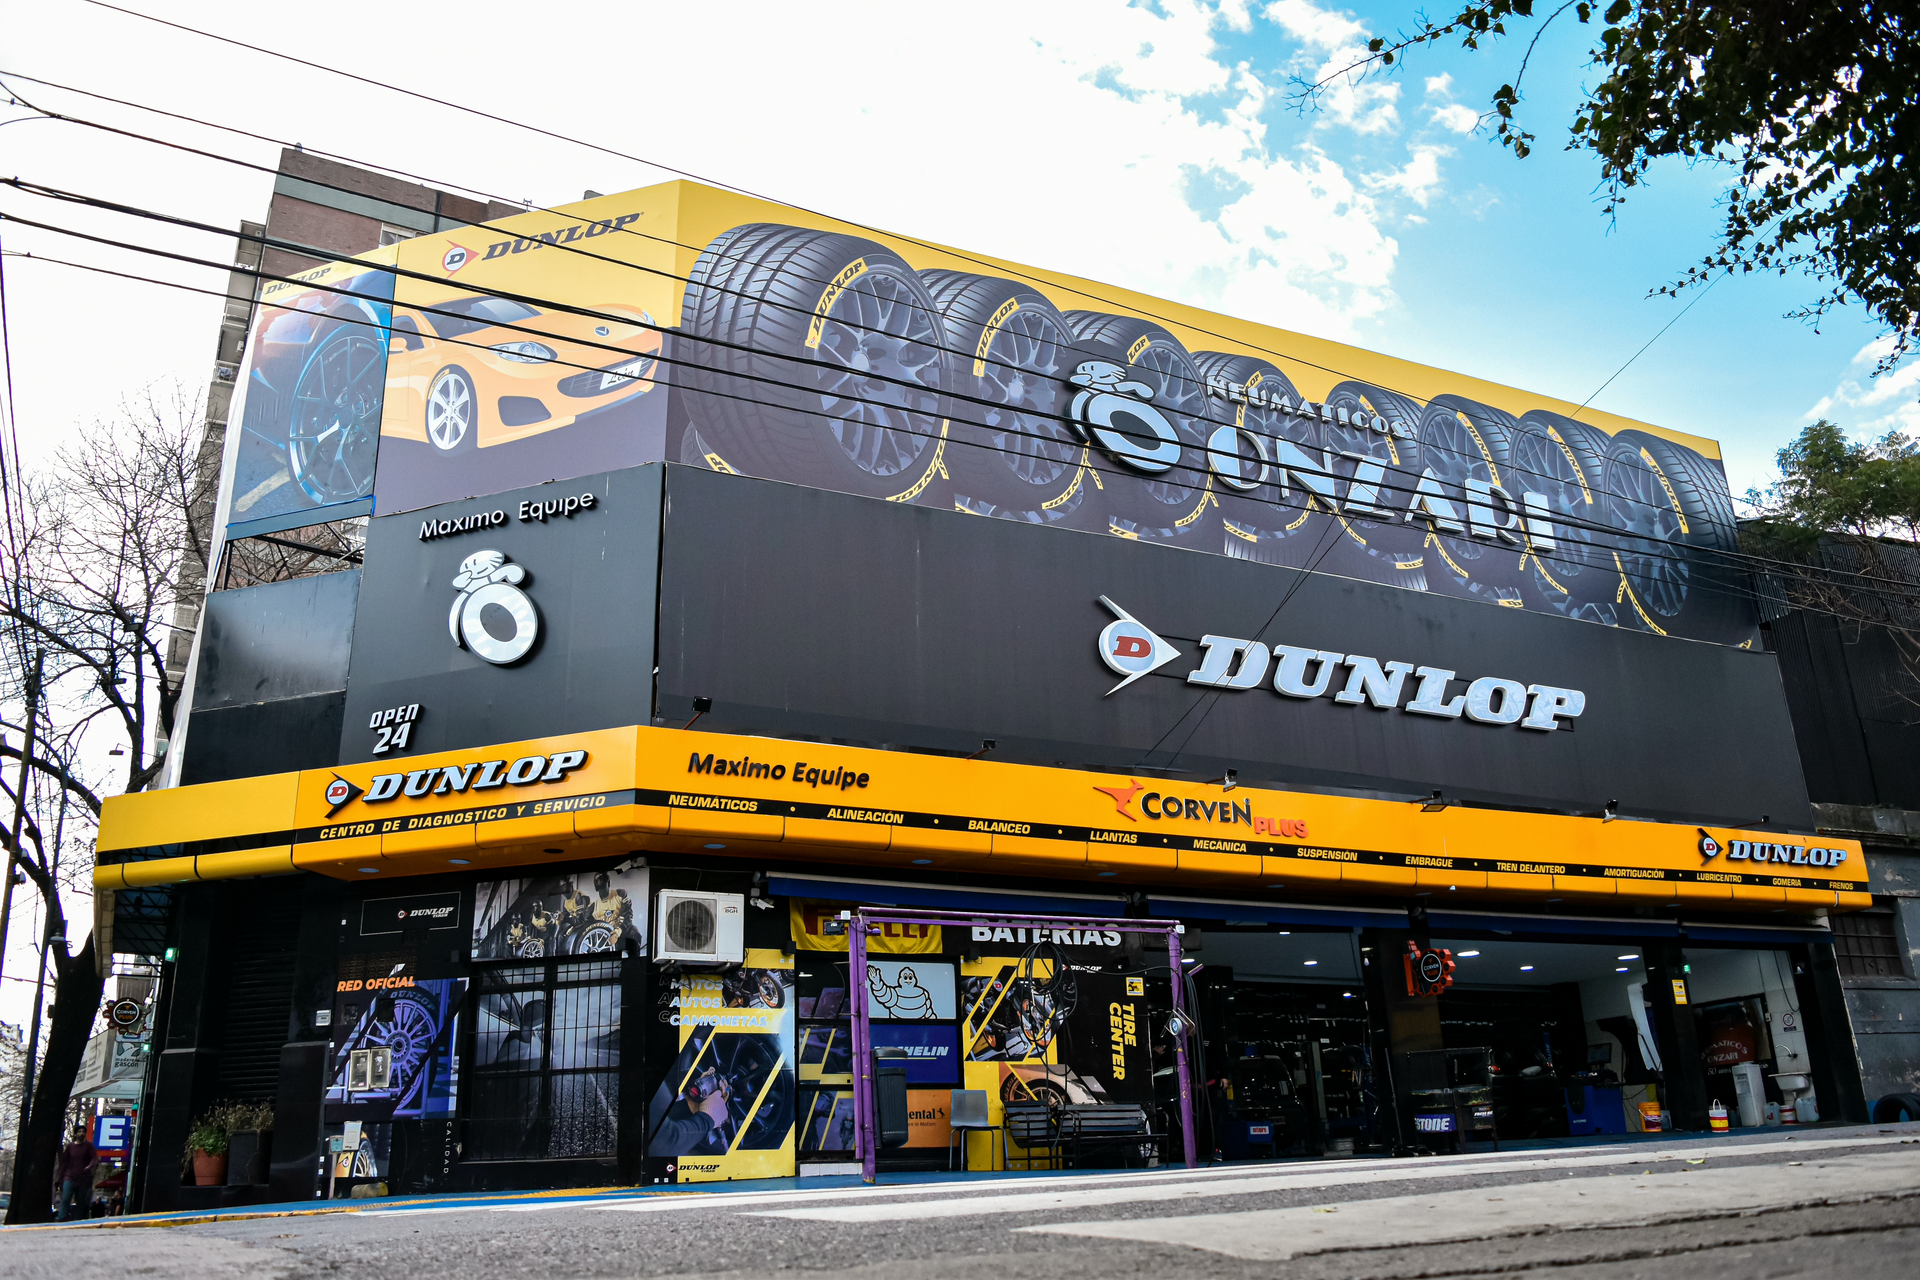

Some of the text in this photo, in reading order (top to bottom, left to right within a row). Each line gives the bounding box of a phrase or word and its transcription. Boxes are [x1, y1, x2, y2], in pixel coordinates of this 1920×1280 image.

[481, 212, 641, 261] DUNLOP
[812, 261, 864, 337] DUNLOP
[975, 300, 1015, 363] DUNLOP
[1466, 425, 1499, 482] DUNLOP
[1207, 424, 1557, 550] ONZARI
[1651, 464, 1687, 529] DUNLOP
[419, 492, 595, 540] Maximo Equipe
[1187, 633, 1586, 732] DUNLOP
[369, 703, 420, 729] OPEN
[372, 722, 412, 755] 24
[361, 750, 589, 803] DUNLOP
[687, 752, 871, 791] Maximo Equipe
[319, 795, 606, 840] CENTRO DE DIAGNOSTICO Y SERVICIO
[1139, 791, 1310, 839] CORVEN PLUS
[827, 808, 904, 825] ALINEACIÓN
[968, 819, 1031, 835] BALANCEO
[1089, 830, 1138, 845] LLANTAS
[1297, 847, 1358, 862] SUSPENSIÓN
[1405, 855, 1454, 868] EMBRAGUE
[1496, 862, 1518, 873] TREN
[1519, 863, 1566, 875] DELANTERO
[1604, 867, 1665, 880] AMORTIGUACIÓN
[1696, 872, 1742, 883] LUBRICENTRO
[1829, 882, 1854, 890] FRENOS
[1728, 838, 1848, 868] DUNLOP
[409, 907, 454, 917] DUNLOP
[971, 917, 1122, 947] BATERIAS
[336, 976, 416, 993] RED OFICIAL
[669, 996, 721, 1009] AUTOS
[670, 978, 724, 991] MOTOS
[669, 1014, 768, 1027] CAMIONETAS
[1108, 1001, 1126, 1081] CENTER
[1122, 1002, 1138, 1048] TIRE
[99, 1117, 126, 1147] E
[443, 1120, 453, 1174] CALIDAD
